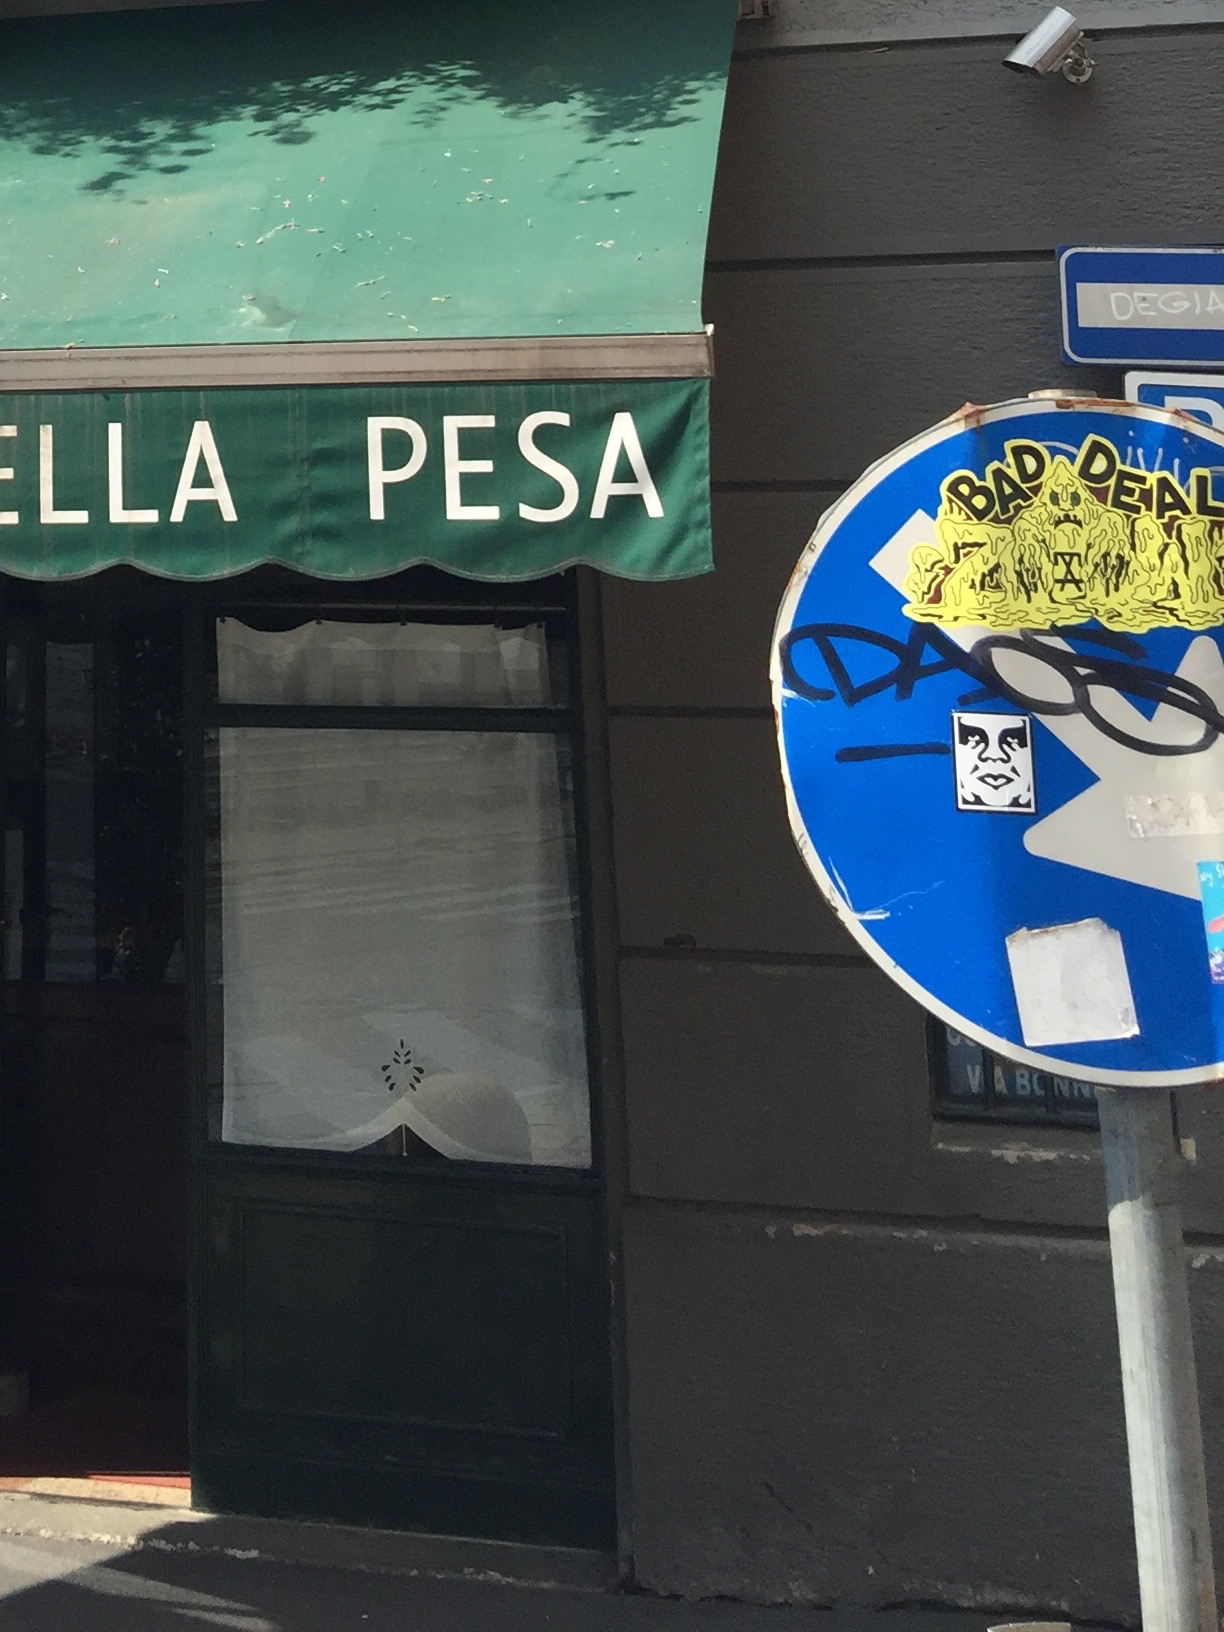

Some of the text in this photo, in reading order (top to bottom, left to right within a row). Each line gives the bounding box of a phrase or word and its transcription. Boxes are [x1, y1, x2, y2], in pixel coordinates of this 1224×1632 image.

[366, 410, 666, 523] PESA
[947, 443, 1047, 522] BAD
[1077, 439, 1224, 520] DEAL
